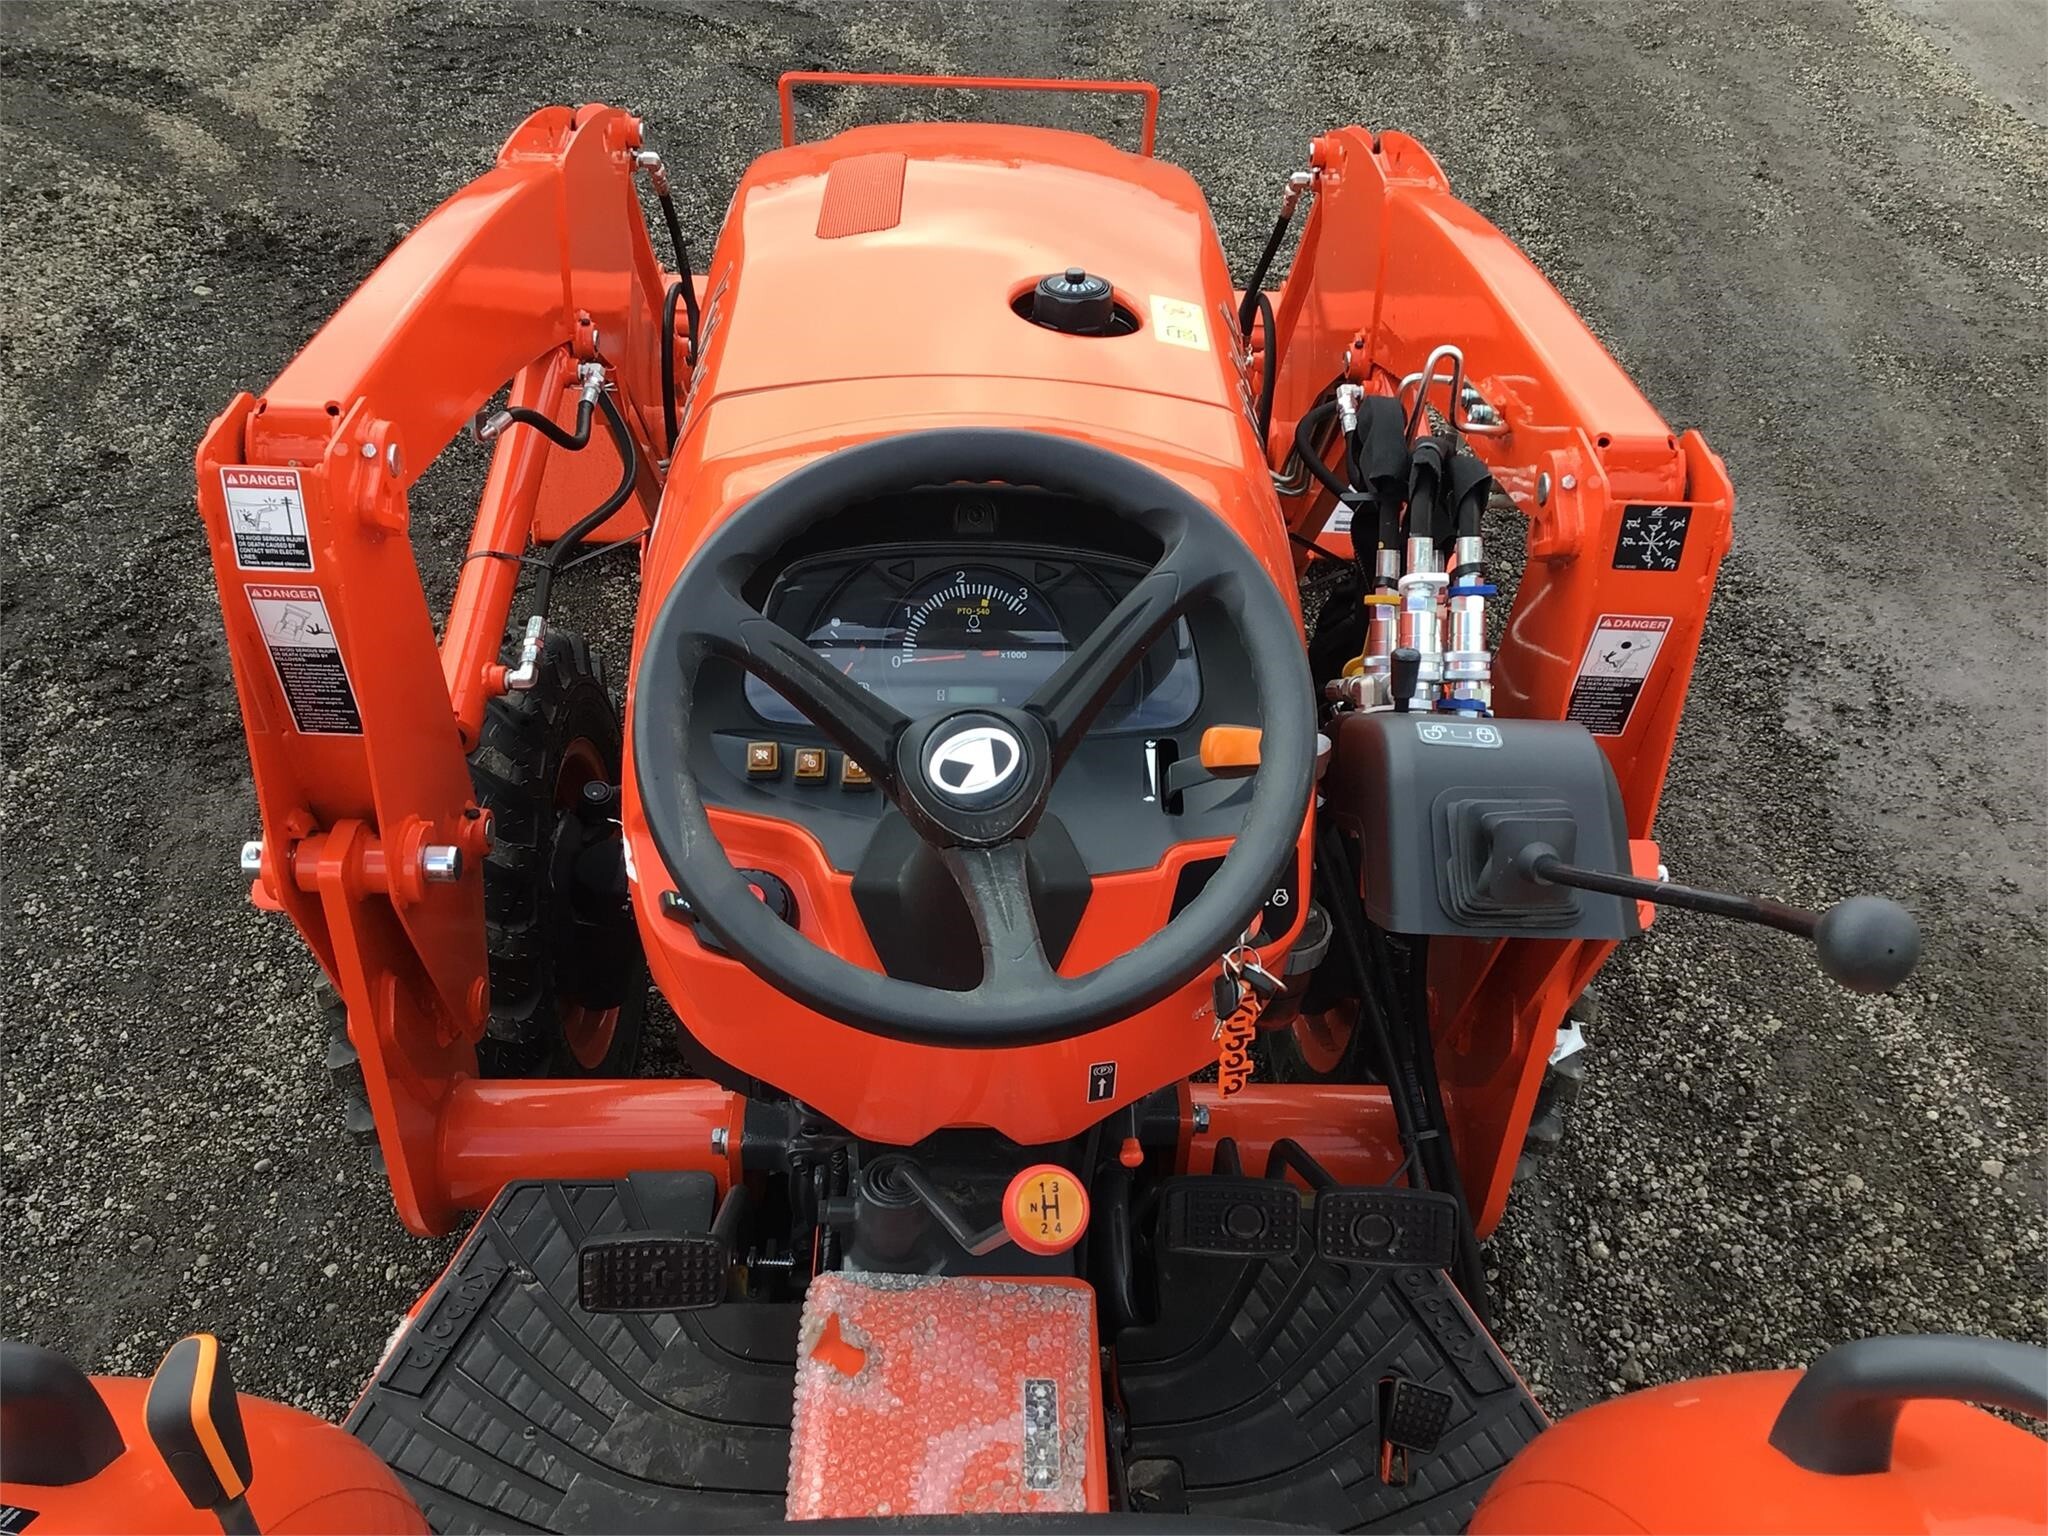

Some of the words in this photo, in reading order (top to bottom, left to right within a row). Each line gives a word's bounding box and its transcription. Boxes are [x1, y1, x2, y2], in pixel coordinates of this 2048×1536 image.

[239, 474, 296, 486] DANGER
[956, 571, 966, 582] 2
[262, 589, 318, 599] DANGER
[1019, 588, 1028, 599] 3
[904, 606, 911, 618] 1
[1613, 619, 1667, 629] DANGER
[1000, 651, 1027, 659] x1000
[892, 656, 901, 668] 0
[1224, 995, 1255, 1096] Kubota
[1039, 1182, 1044, 1193] 1
[1052, 1182, 1059, 1192] 3
[1030, 1203, 1037, 1212] N
[1041, 1223, 1048, 1234] 2
[1055, 1222, 1061, 1233] 4
[408, 1266, 503, 1369] Kubota
